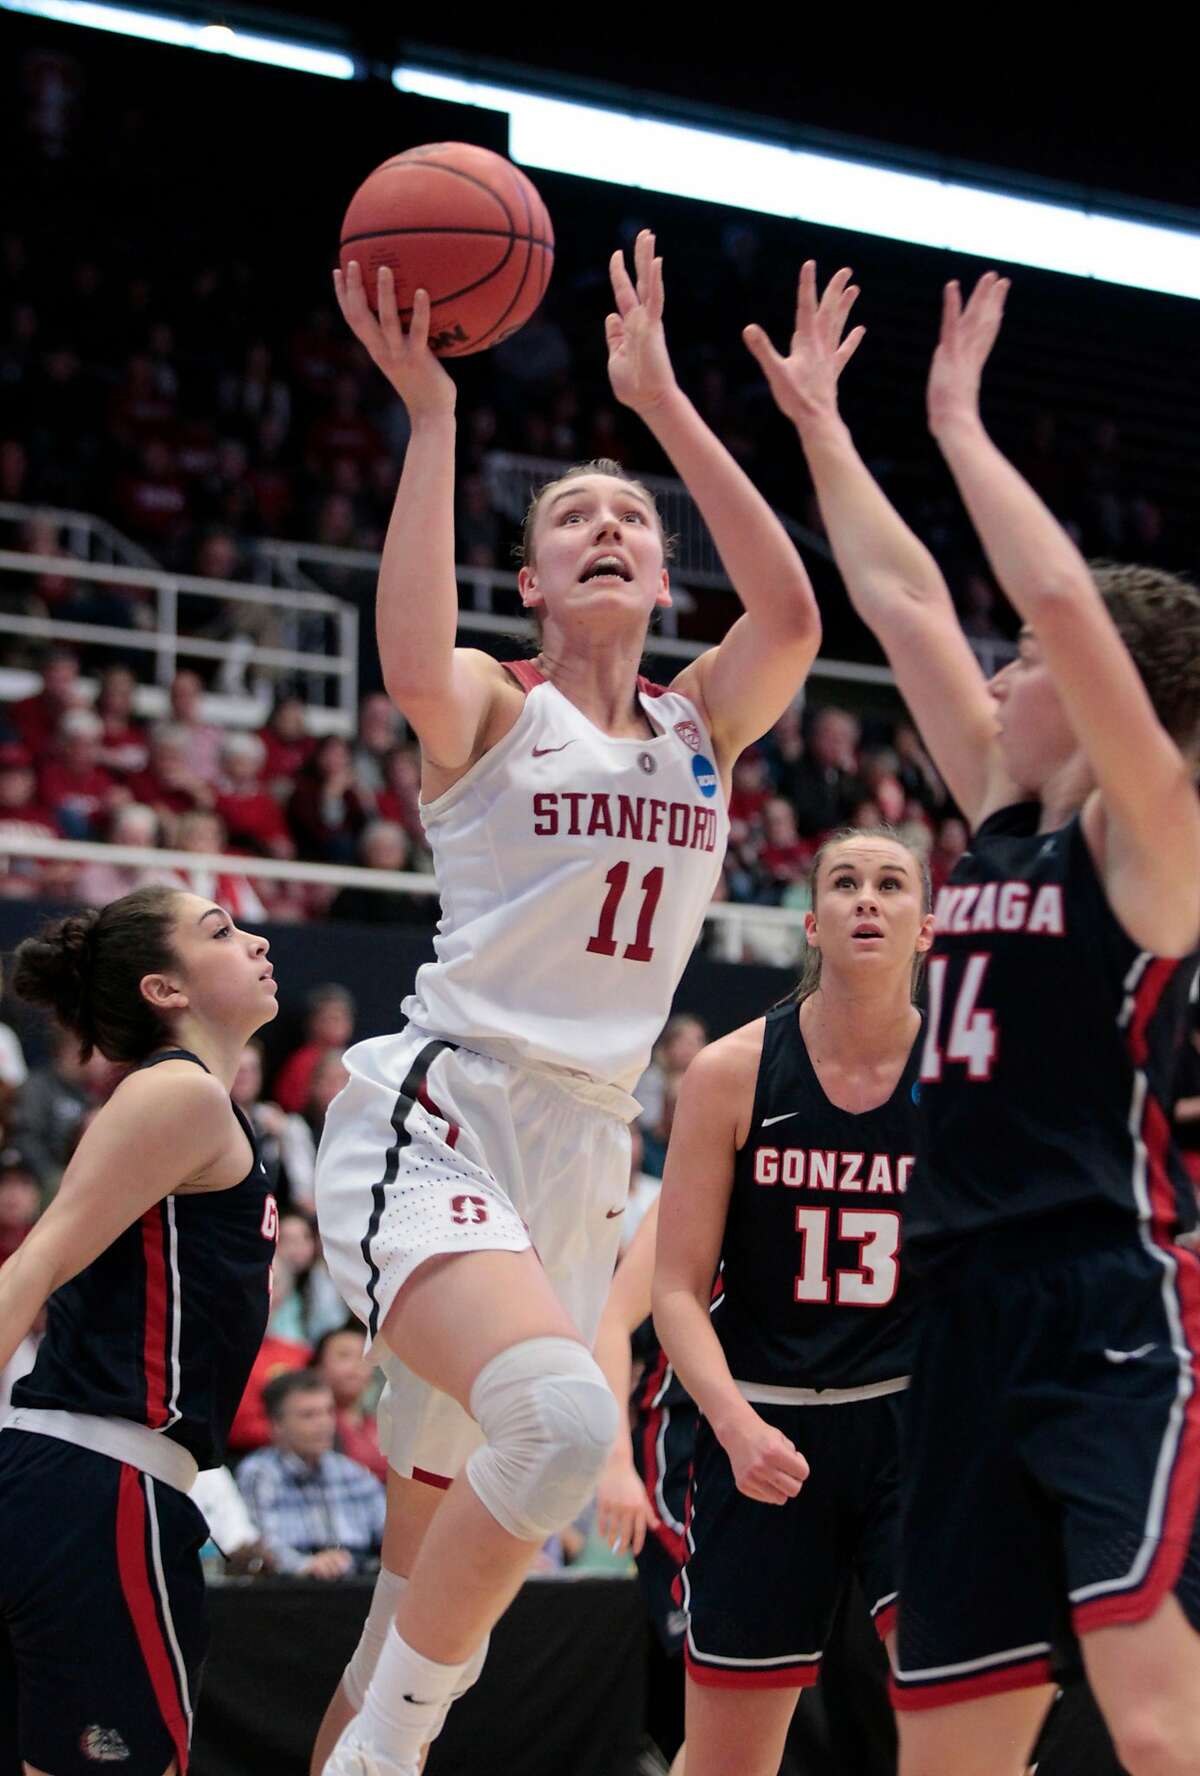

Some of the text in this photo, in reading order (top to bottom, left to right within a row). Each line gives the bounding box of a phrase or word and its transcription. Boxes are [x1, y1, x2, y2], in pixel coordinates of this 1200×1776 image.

[532, 792, 718, 852] STANFORD
[585, 860, 665, 962] 11
[932, 879, 1067, 937] NZAGA
[919, 953, 999, 1084] 14
[754, 1146, 916, 1195] GONZA
[794, 1205, 903, 1308] 13
